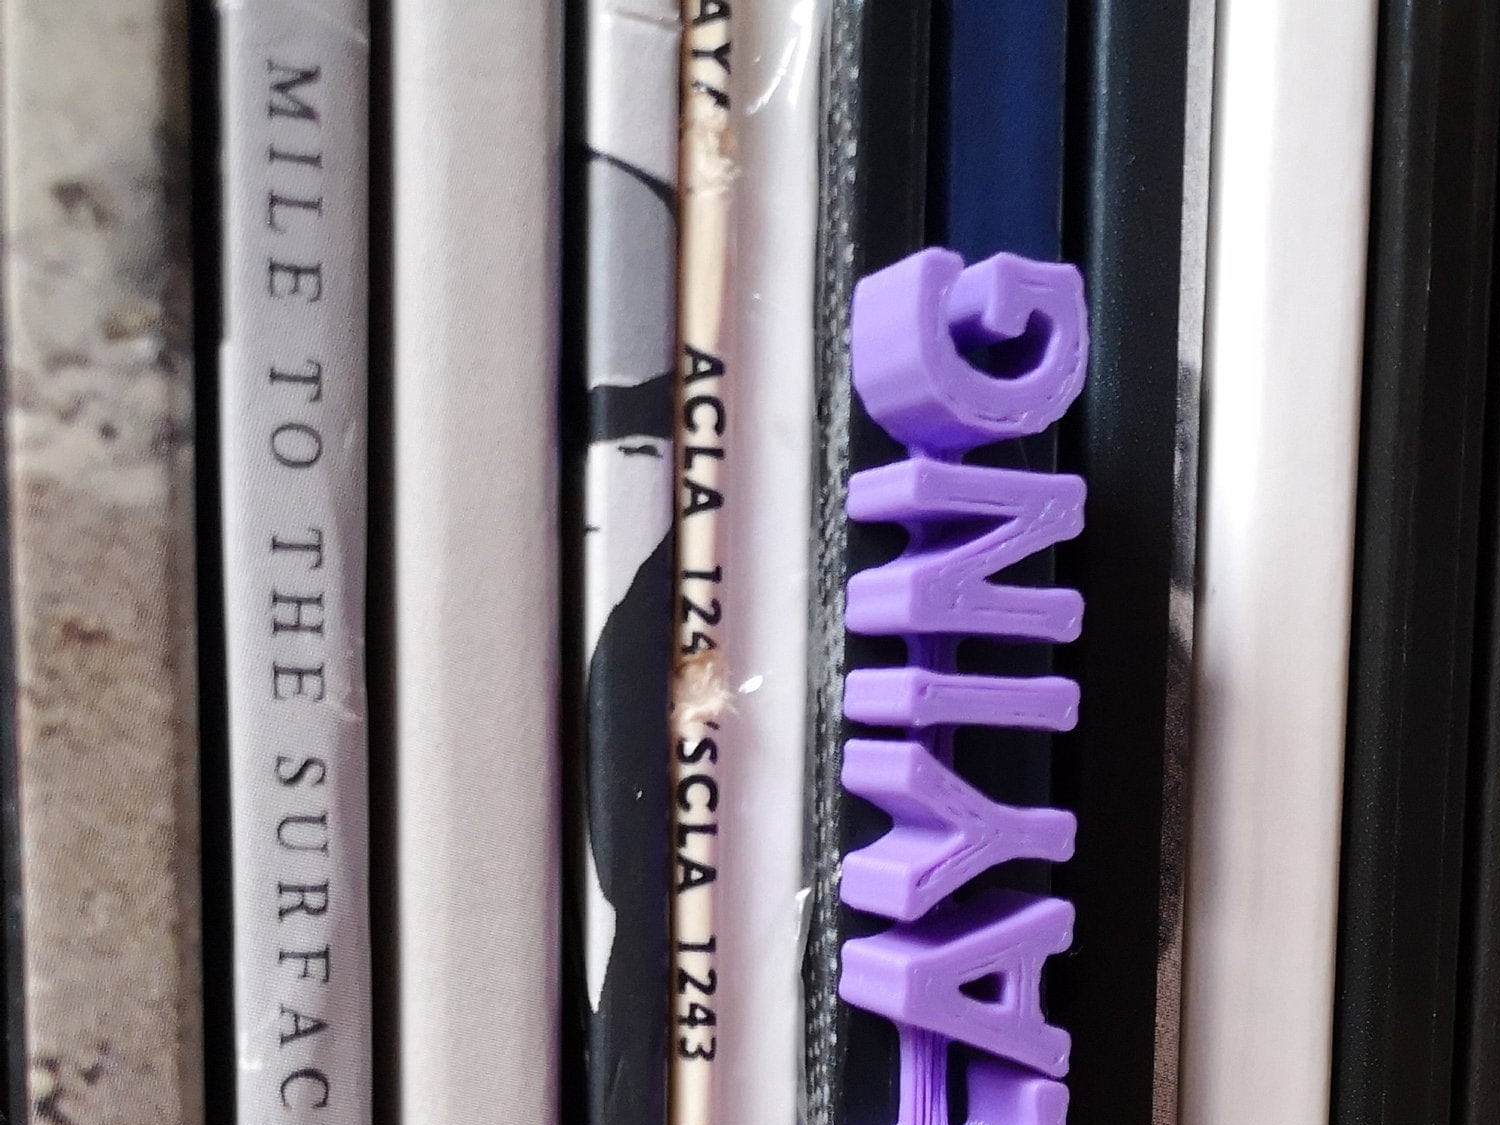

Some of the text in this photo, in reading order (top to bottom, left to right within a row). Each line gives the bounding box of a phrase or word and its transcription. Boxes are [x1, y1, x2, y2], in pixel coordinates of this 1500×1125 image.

[266, 60, 323, 304] MILE
[268, 360, 324, 470] TO
[681, 344, 726, 519] ACLA
[271, 527, 325, 702] THE
[680, 564, 723, 657] 124
[676, 936, 718, 1064] 1243
